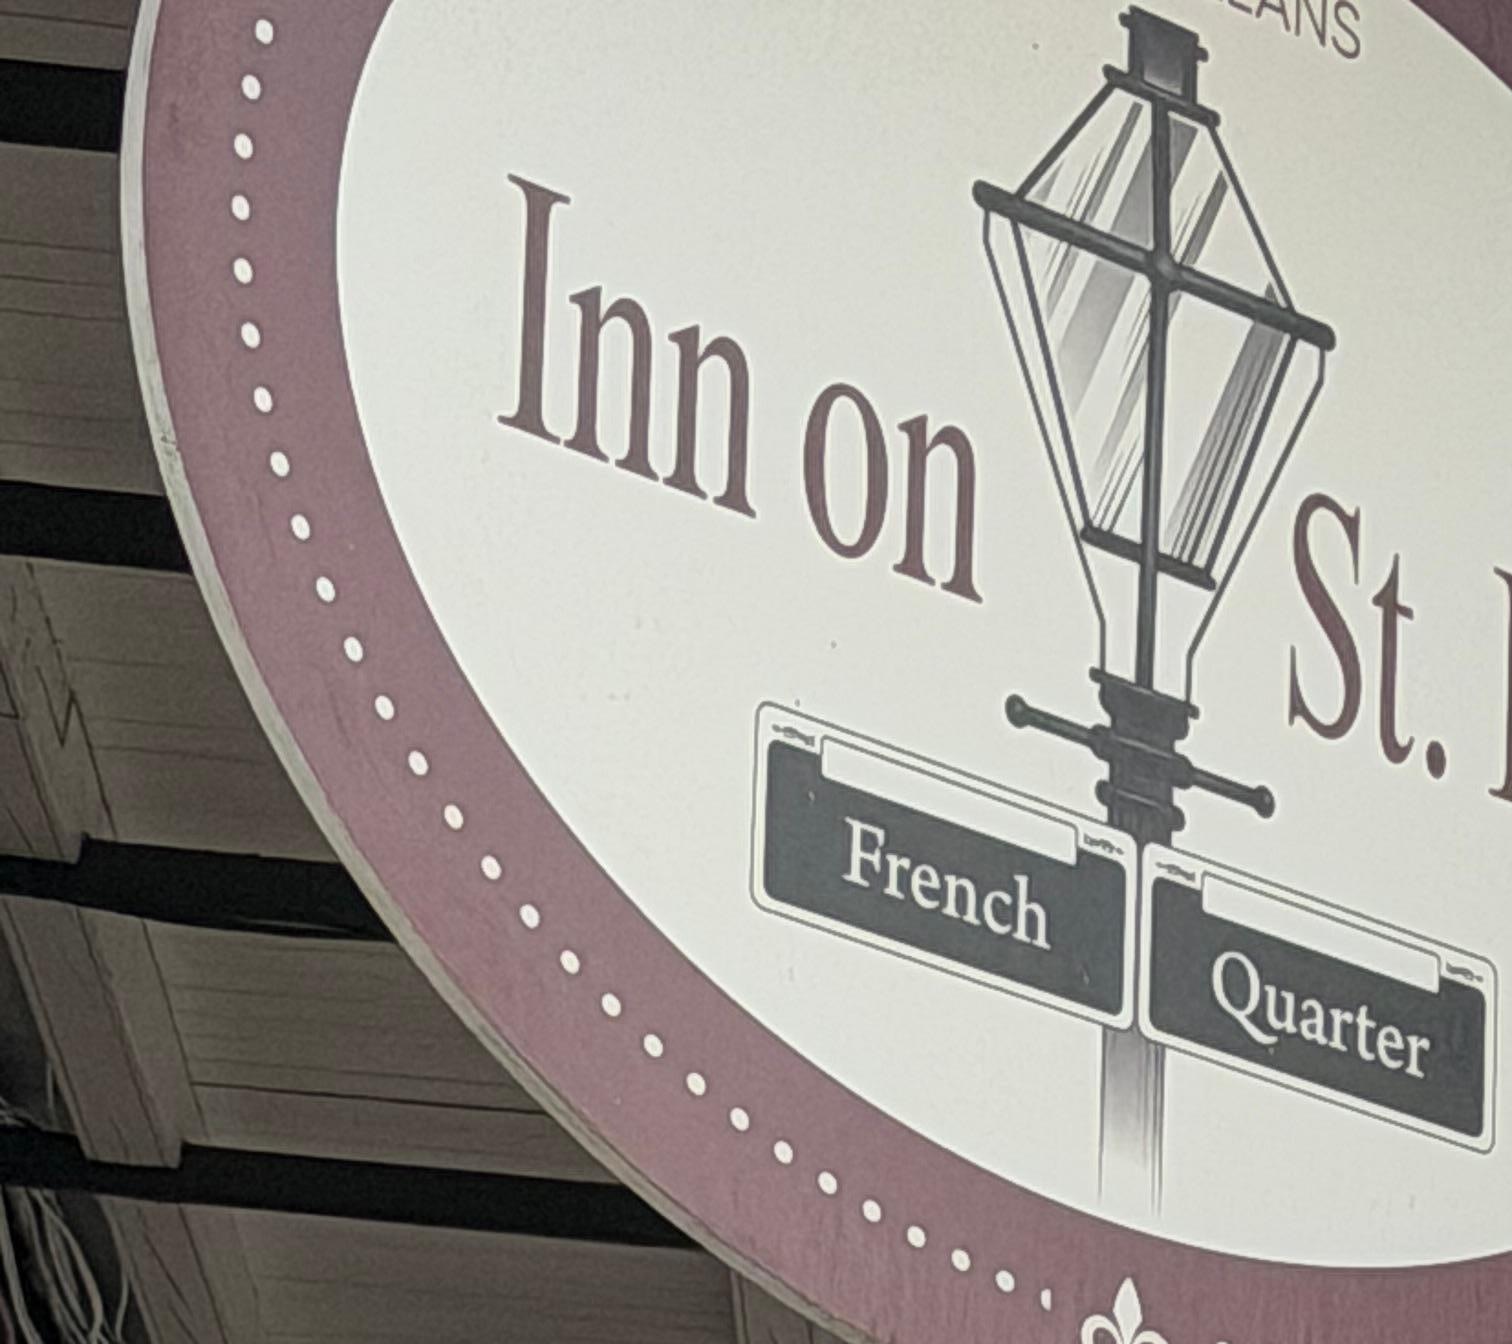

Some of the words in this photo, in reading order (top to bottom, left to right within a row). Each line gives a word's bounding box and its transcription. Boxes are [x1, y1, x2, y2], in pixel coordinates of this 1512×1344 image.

[497, 173, 757, 519] Inn
[803, 382, 983, 604] on
[1288, 492, 1447, 780] St.
[841, 815, 1052, 951] French
[1211, 950, 1431, 1079] Quarter
